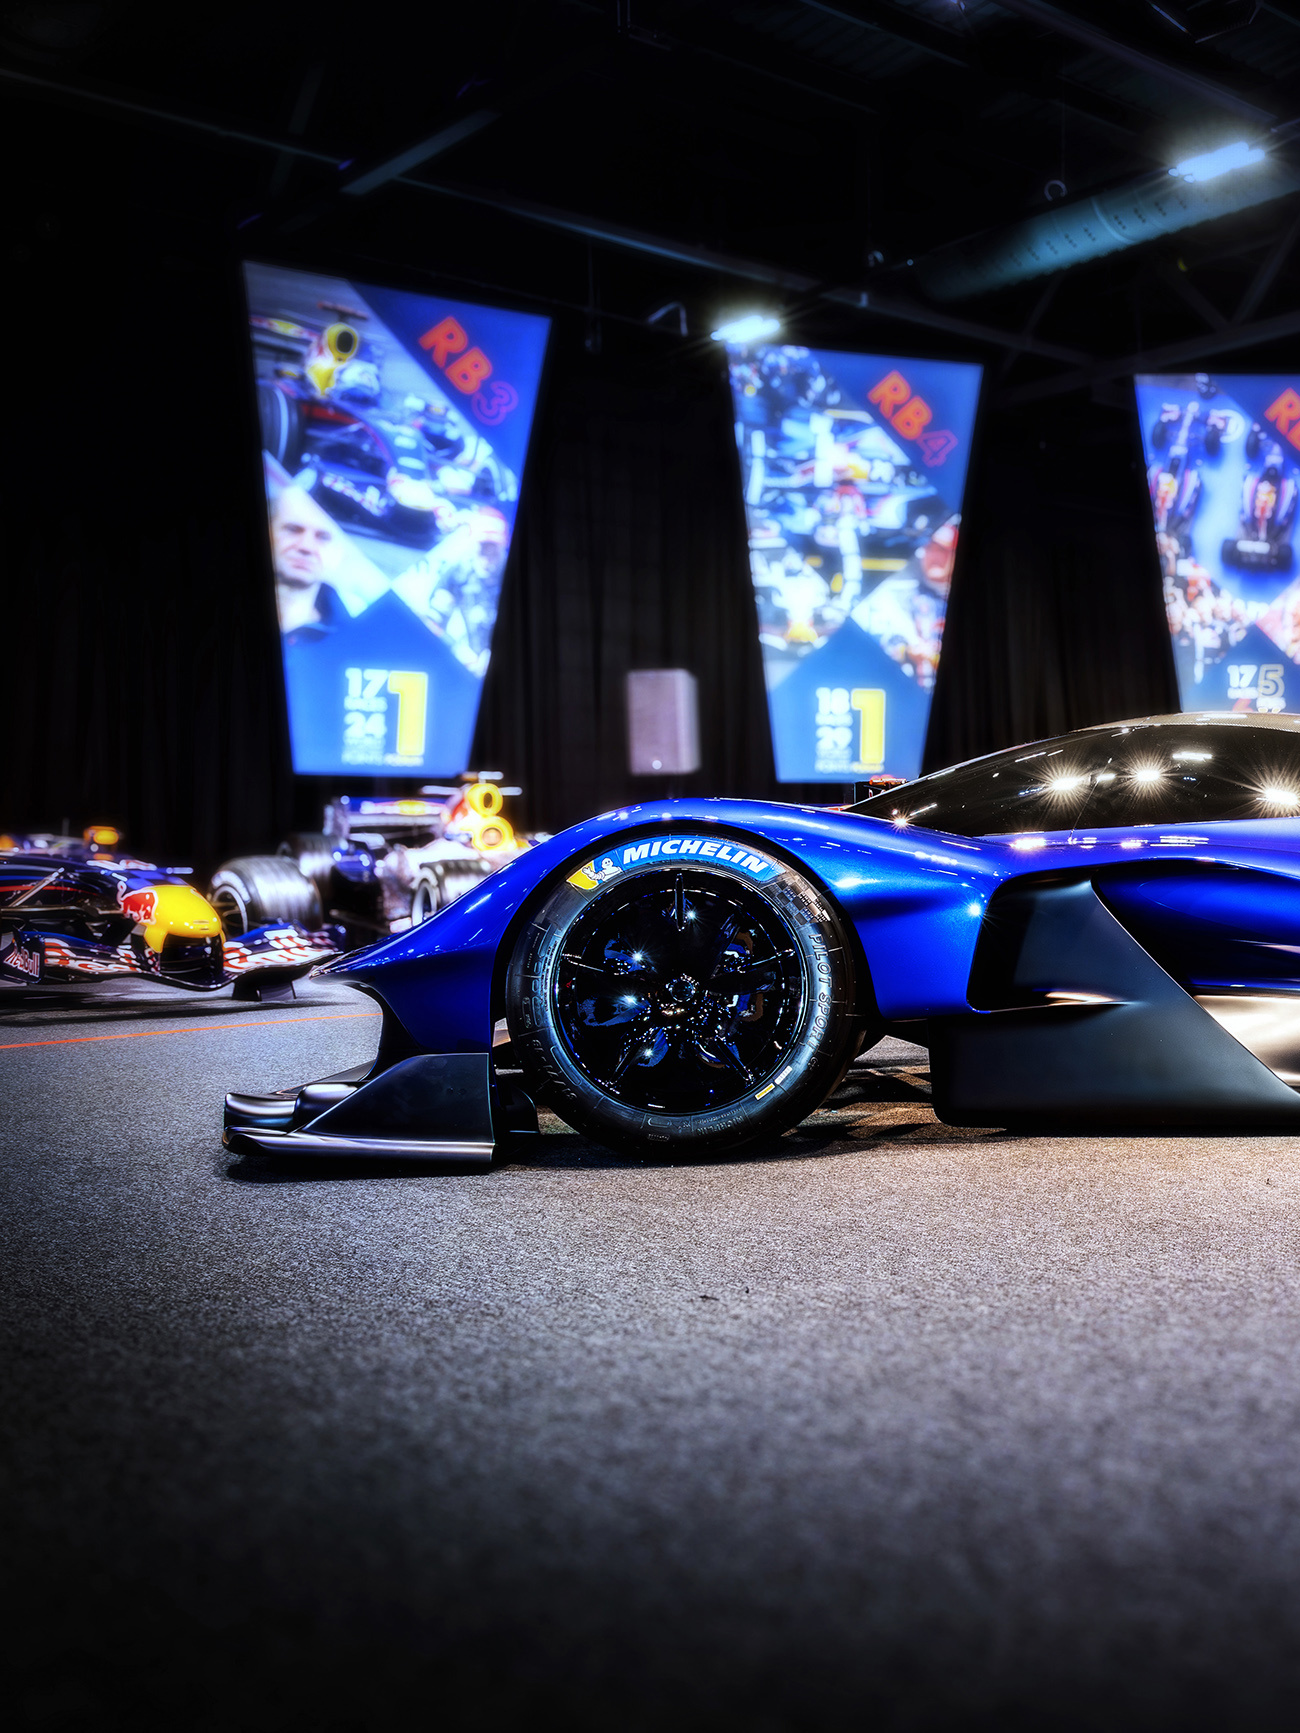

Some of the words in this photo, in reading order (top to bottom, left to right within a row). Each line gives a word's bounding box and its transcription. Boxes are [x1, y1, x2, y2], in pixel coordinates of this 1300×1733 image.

[418, 315, 519, 426] RB3
[867, 369, 958, 468] RB4
[345, 667, 389, 698] 17
[387, 670, 429, 756] 1
[850, 688, 886, 764] 1
[623, 839, 769, 873] MICHELIN
[808, 933, 833, 988] PILOT
[807, 991, 831, 1053] SPORT
